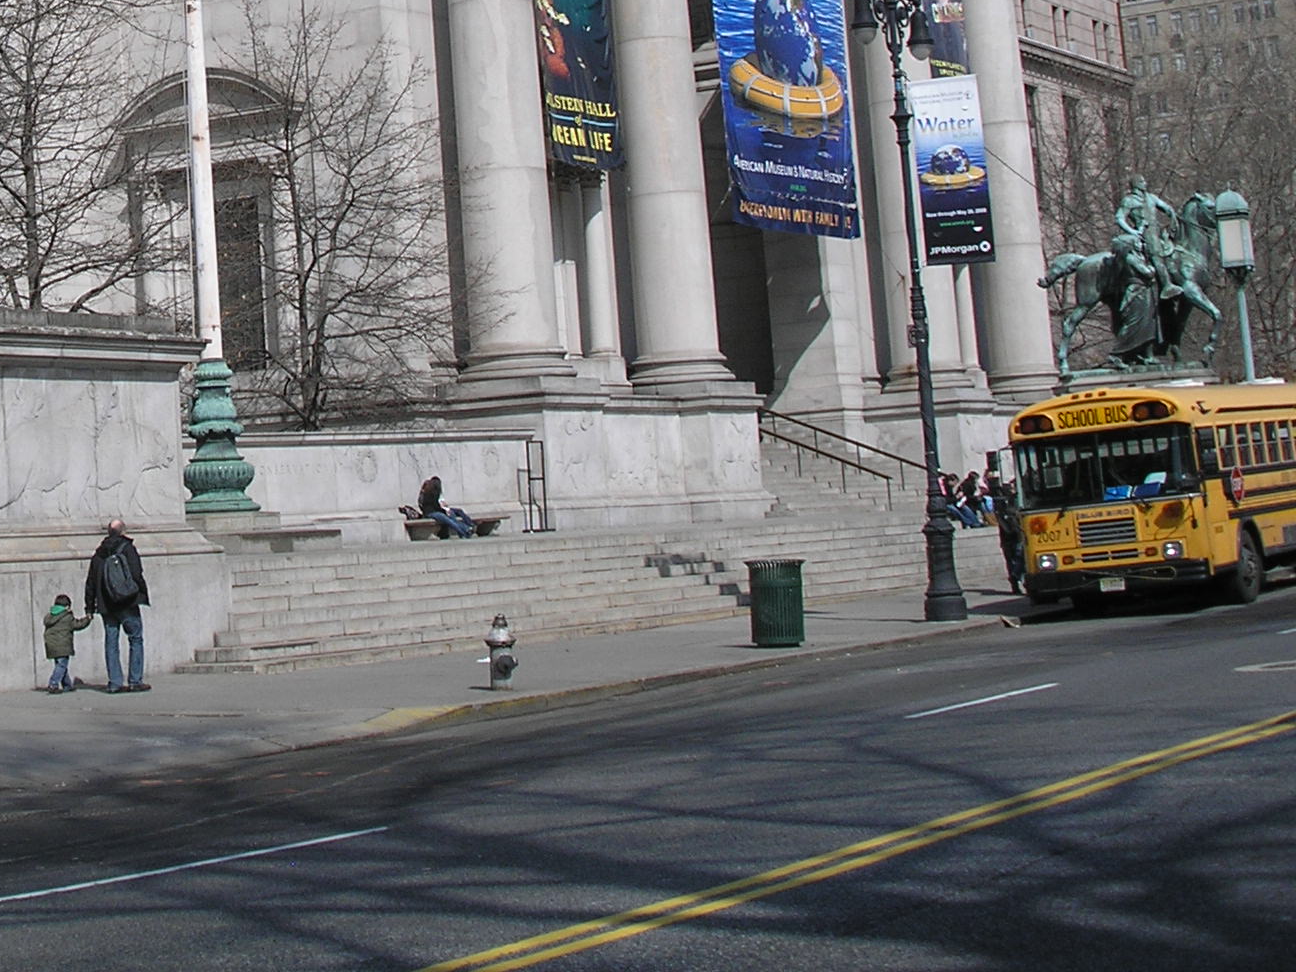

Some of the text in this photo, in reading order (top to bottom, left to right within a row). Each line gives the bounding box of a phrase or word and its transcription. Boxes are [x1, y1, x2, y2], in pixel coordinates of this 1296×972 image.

[585, 100, 616, 118] HALL
[917, 117, 975, 132] Water
[588, 130, 613, 152] LIFE
[929, 244, 979, 255] JPMorgan
[1058, 405, 1129, 429] SCHOOL BUS
[1037, 530, 1061, 543] 2007
